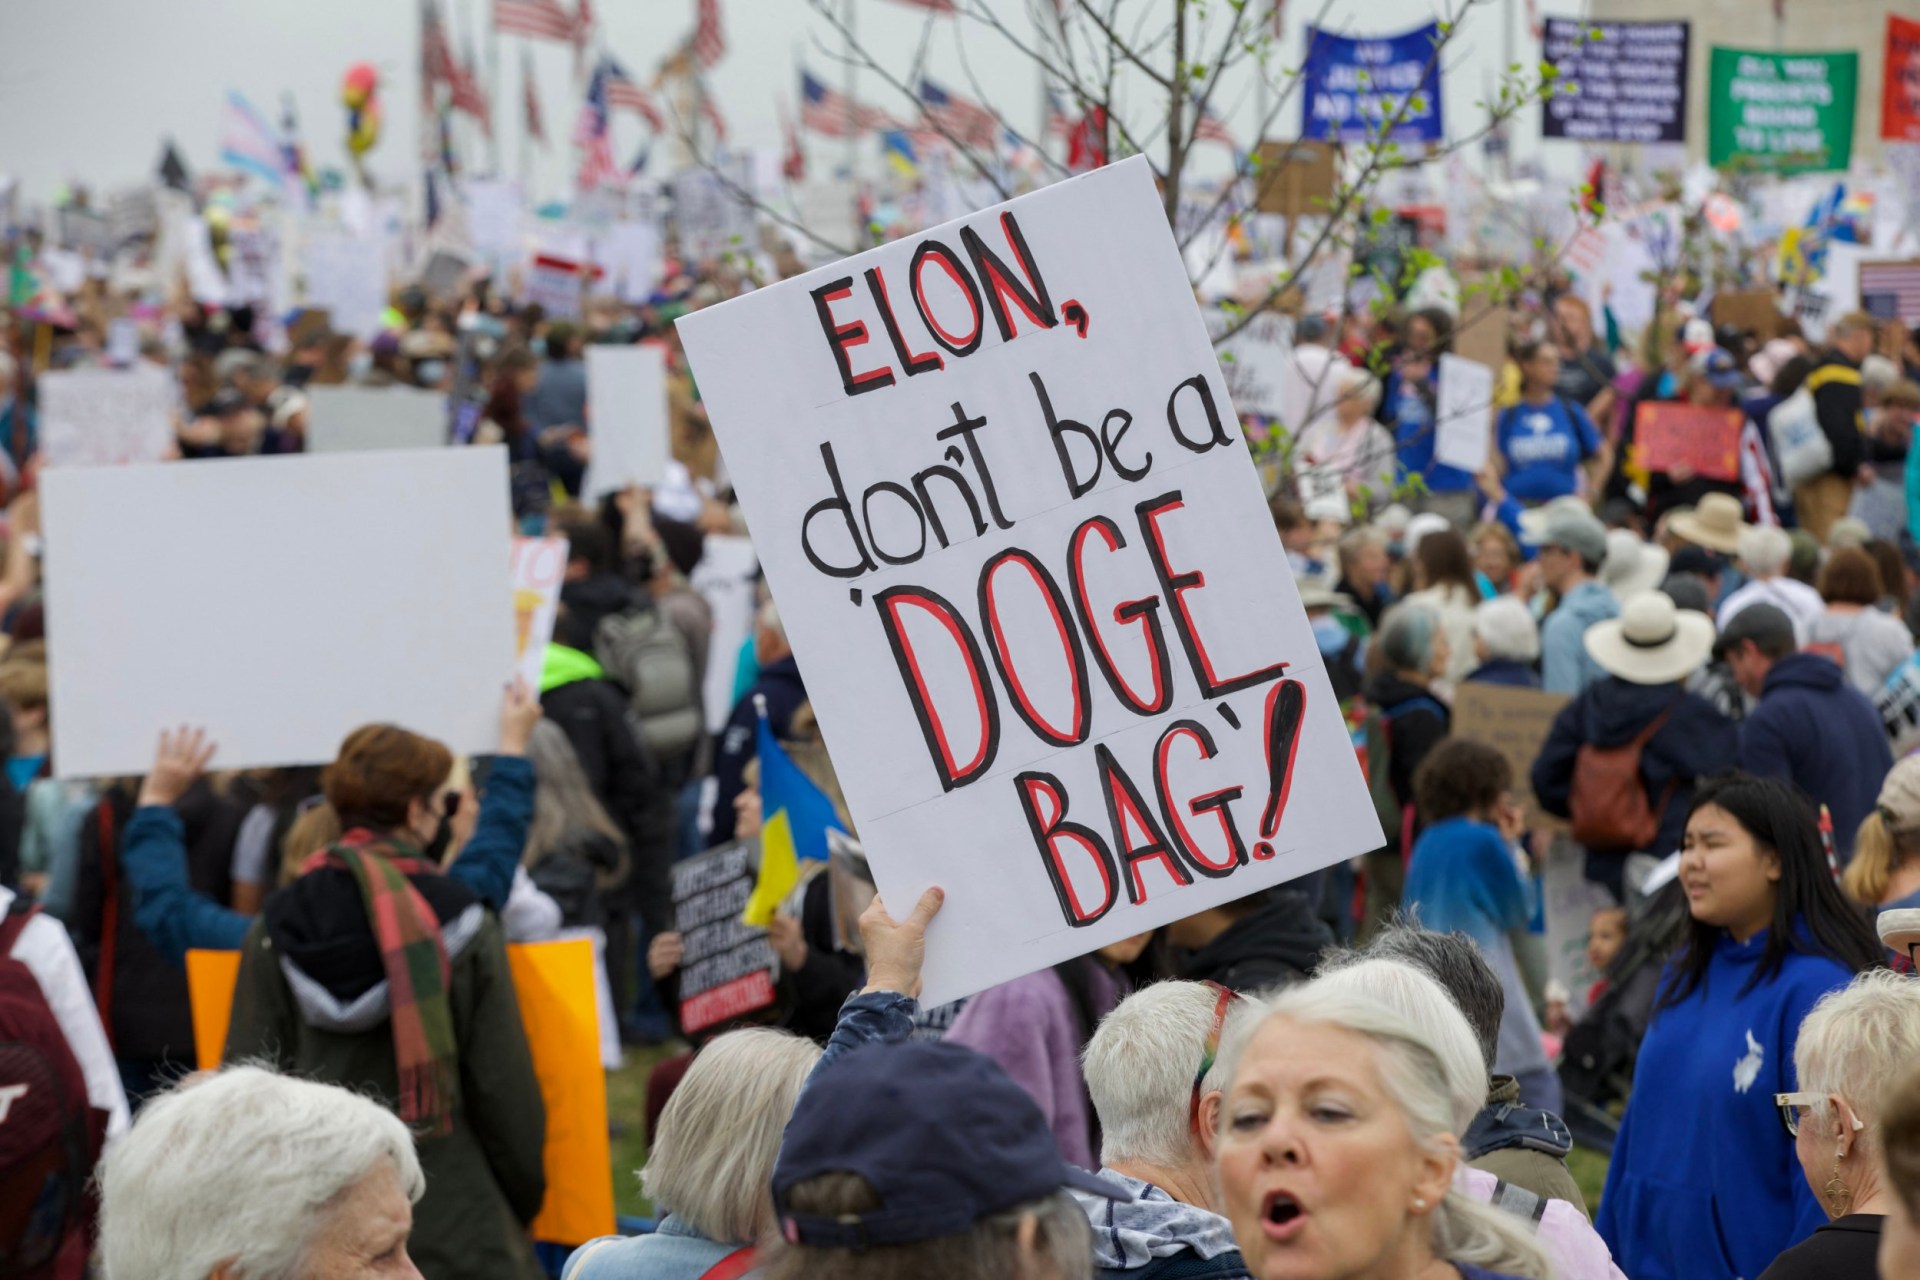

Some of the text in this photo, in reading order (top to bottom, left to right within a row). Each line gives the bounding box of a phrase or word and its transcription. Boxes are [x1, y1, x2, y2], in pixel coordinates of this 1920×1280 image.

[809, 211, 1089, 396] ELON,
[801, 371, 1234, 578] don't be a
